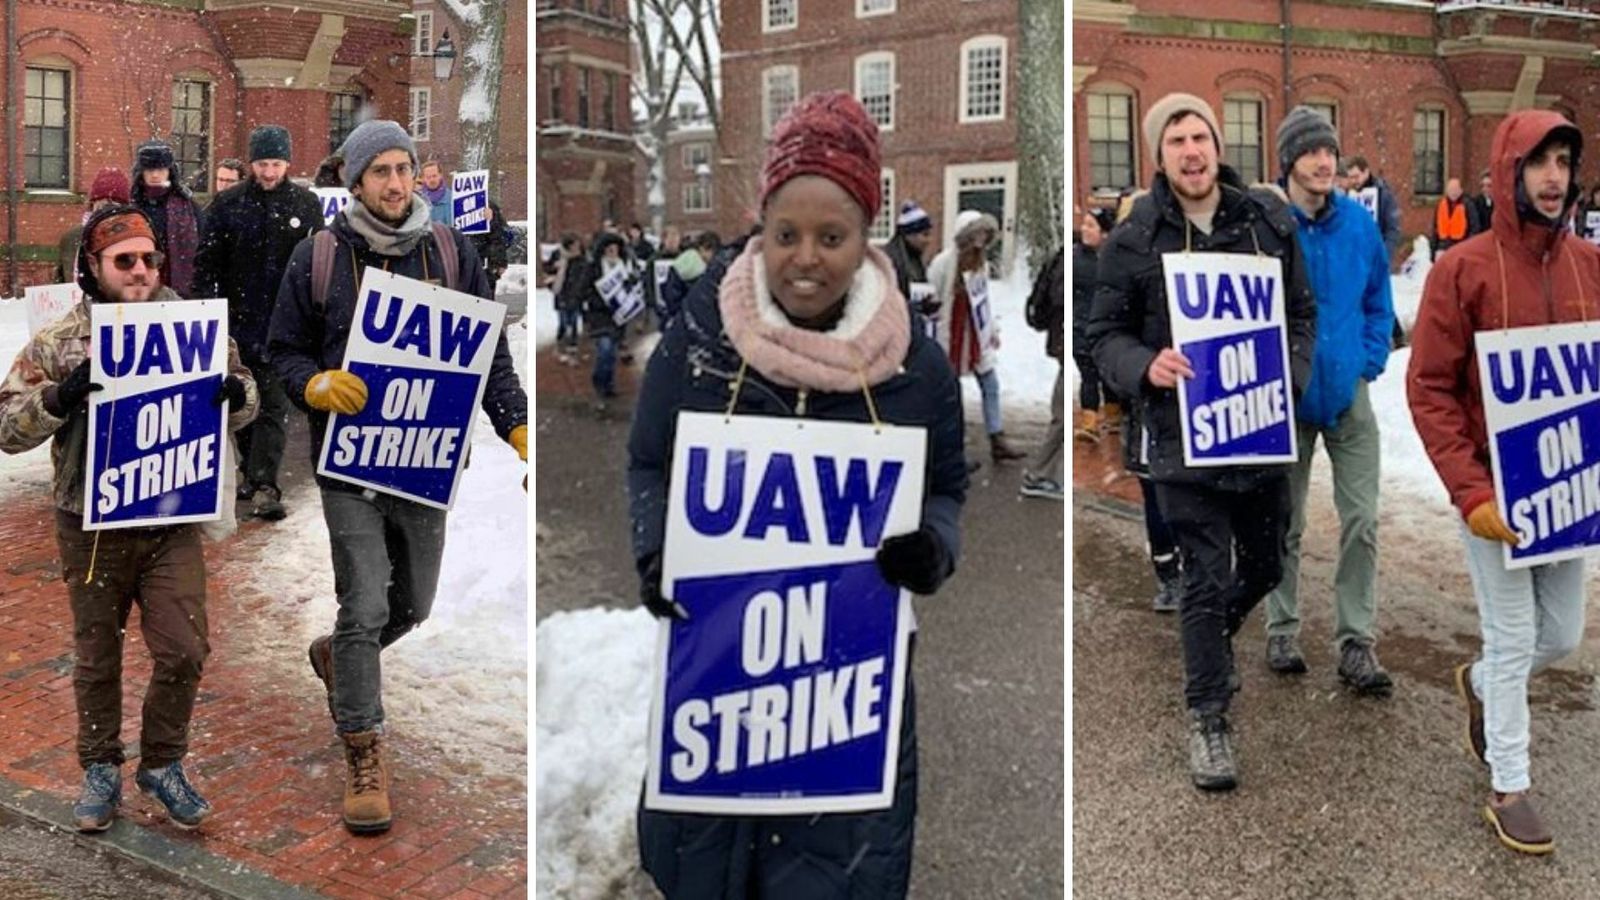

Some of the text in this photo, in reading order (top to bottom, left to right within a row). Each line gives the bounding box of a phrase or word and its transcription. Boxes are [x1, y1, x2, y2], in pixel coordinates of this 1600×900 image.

[454, 174, 486, 192] UAW
[1174, 273, 1274, 321] UAW
[99, 319, 219, 378] UAW
[362, 290, 491, 368] UAW
[1219, 339, 1258, 391] ON
[1488, 341, 1600, 404] UAW
[136, 394, 183, 450] ON
[381, 378, 435, 421] ON
[1192, 378, 1286, 451] STRIKE
[97, 433, 216, 515] STRIKE
[332, 425, 461, 469] STRIKE
[1537, 415, 1584, 479] ON
[684, 447, 904, 548] UAW
[741, 581, 827, 677] ON
[670, 656, 886, 783] STRIKE
